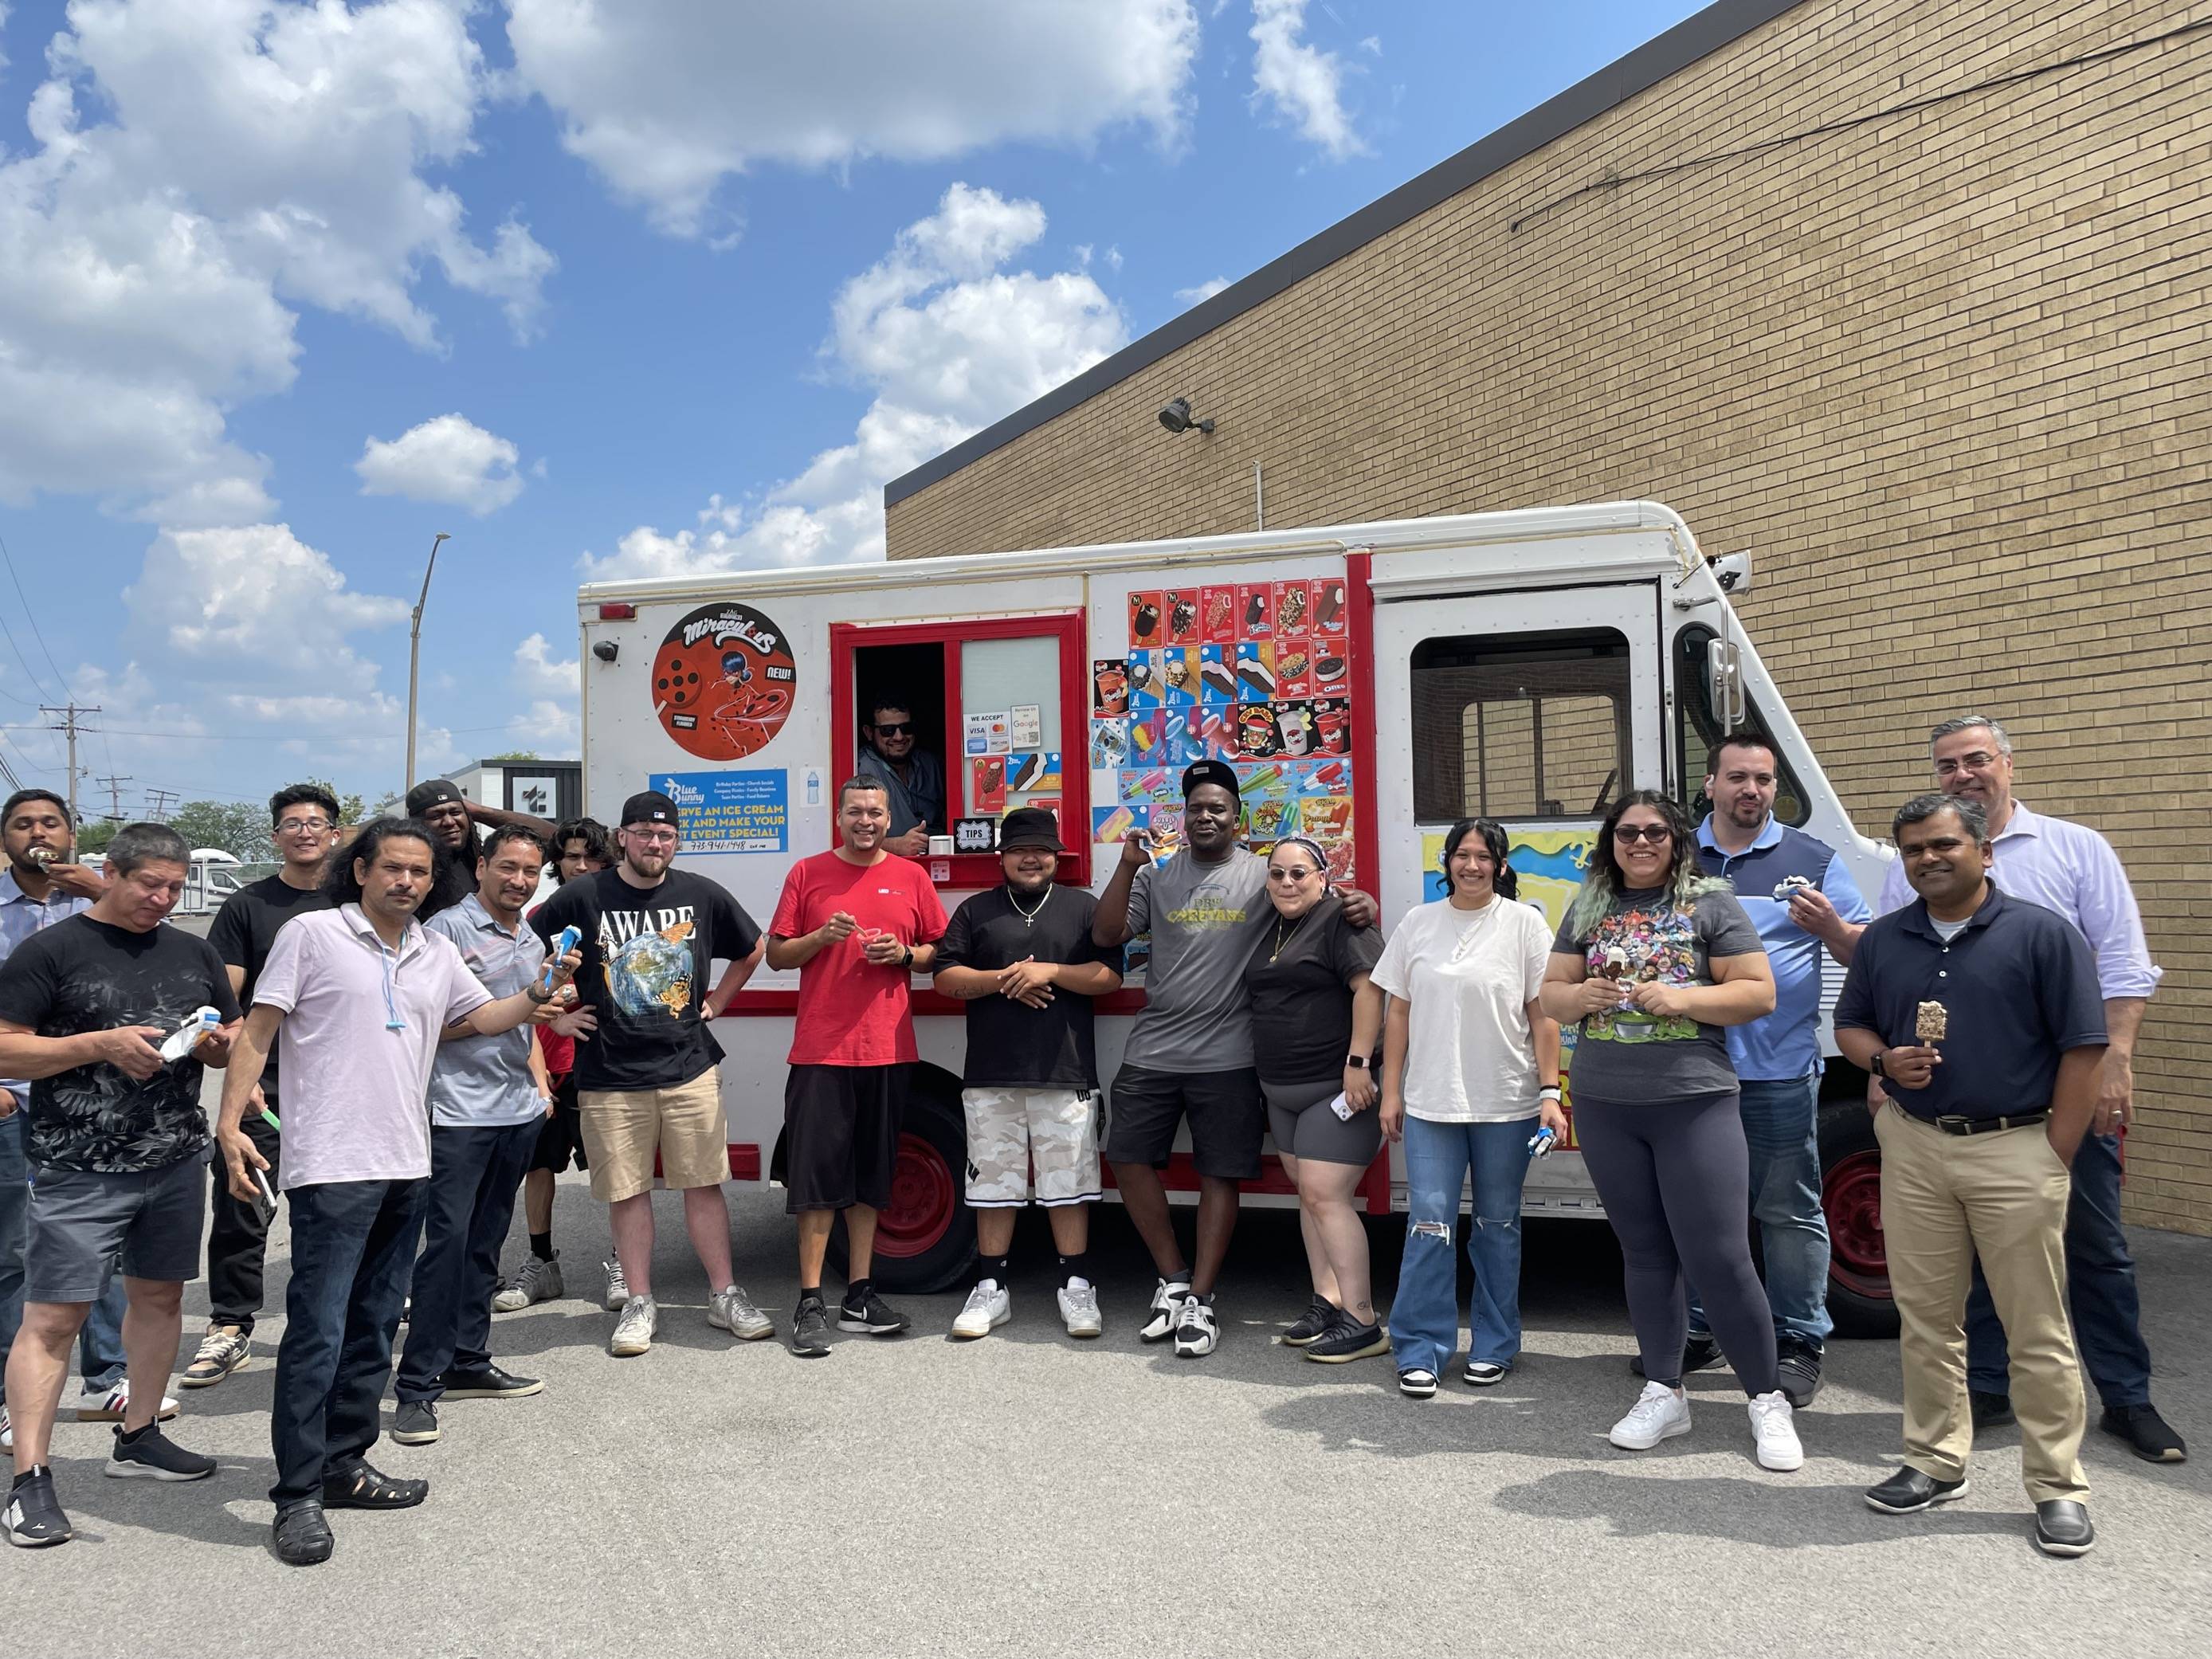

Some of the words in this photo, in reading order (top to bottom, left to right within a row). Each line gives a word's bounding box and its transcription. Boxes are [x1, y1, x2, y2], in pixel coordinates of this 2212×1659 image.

[683, 618, 777, 653] Miraculous
[767, 667, 791, 680] NEW!
[1324, 684, 1346, 692] OREO
[1013, 720, 1037, 728] Google
[704, 807, 720, 816] AN
[724, 806, 741, 815] ICE
[743, 805, 783, 814] CREAM
[692, 818, 716, 828] AND
[719, 817, 751, 826] MAKE
[754, 815, 785, 826] YOUR
[691, 829, 726, 839] EVENT
[729, 827, 779, 837] SPECIAL!
[965, 830, 982, 838] TIPS
[598, 905, 696, 946] AWARE
